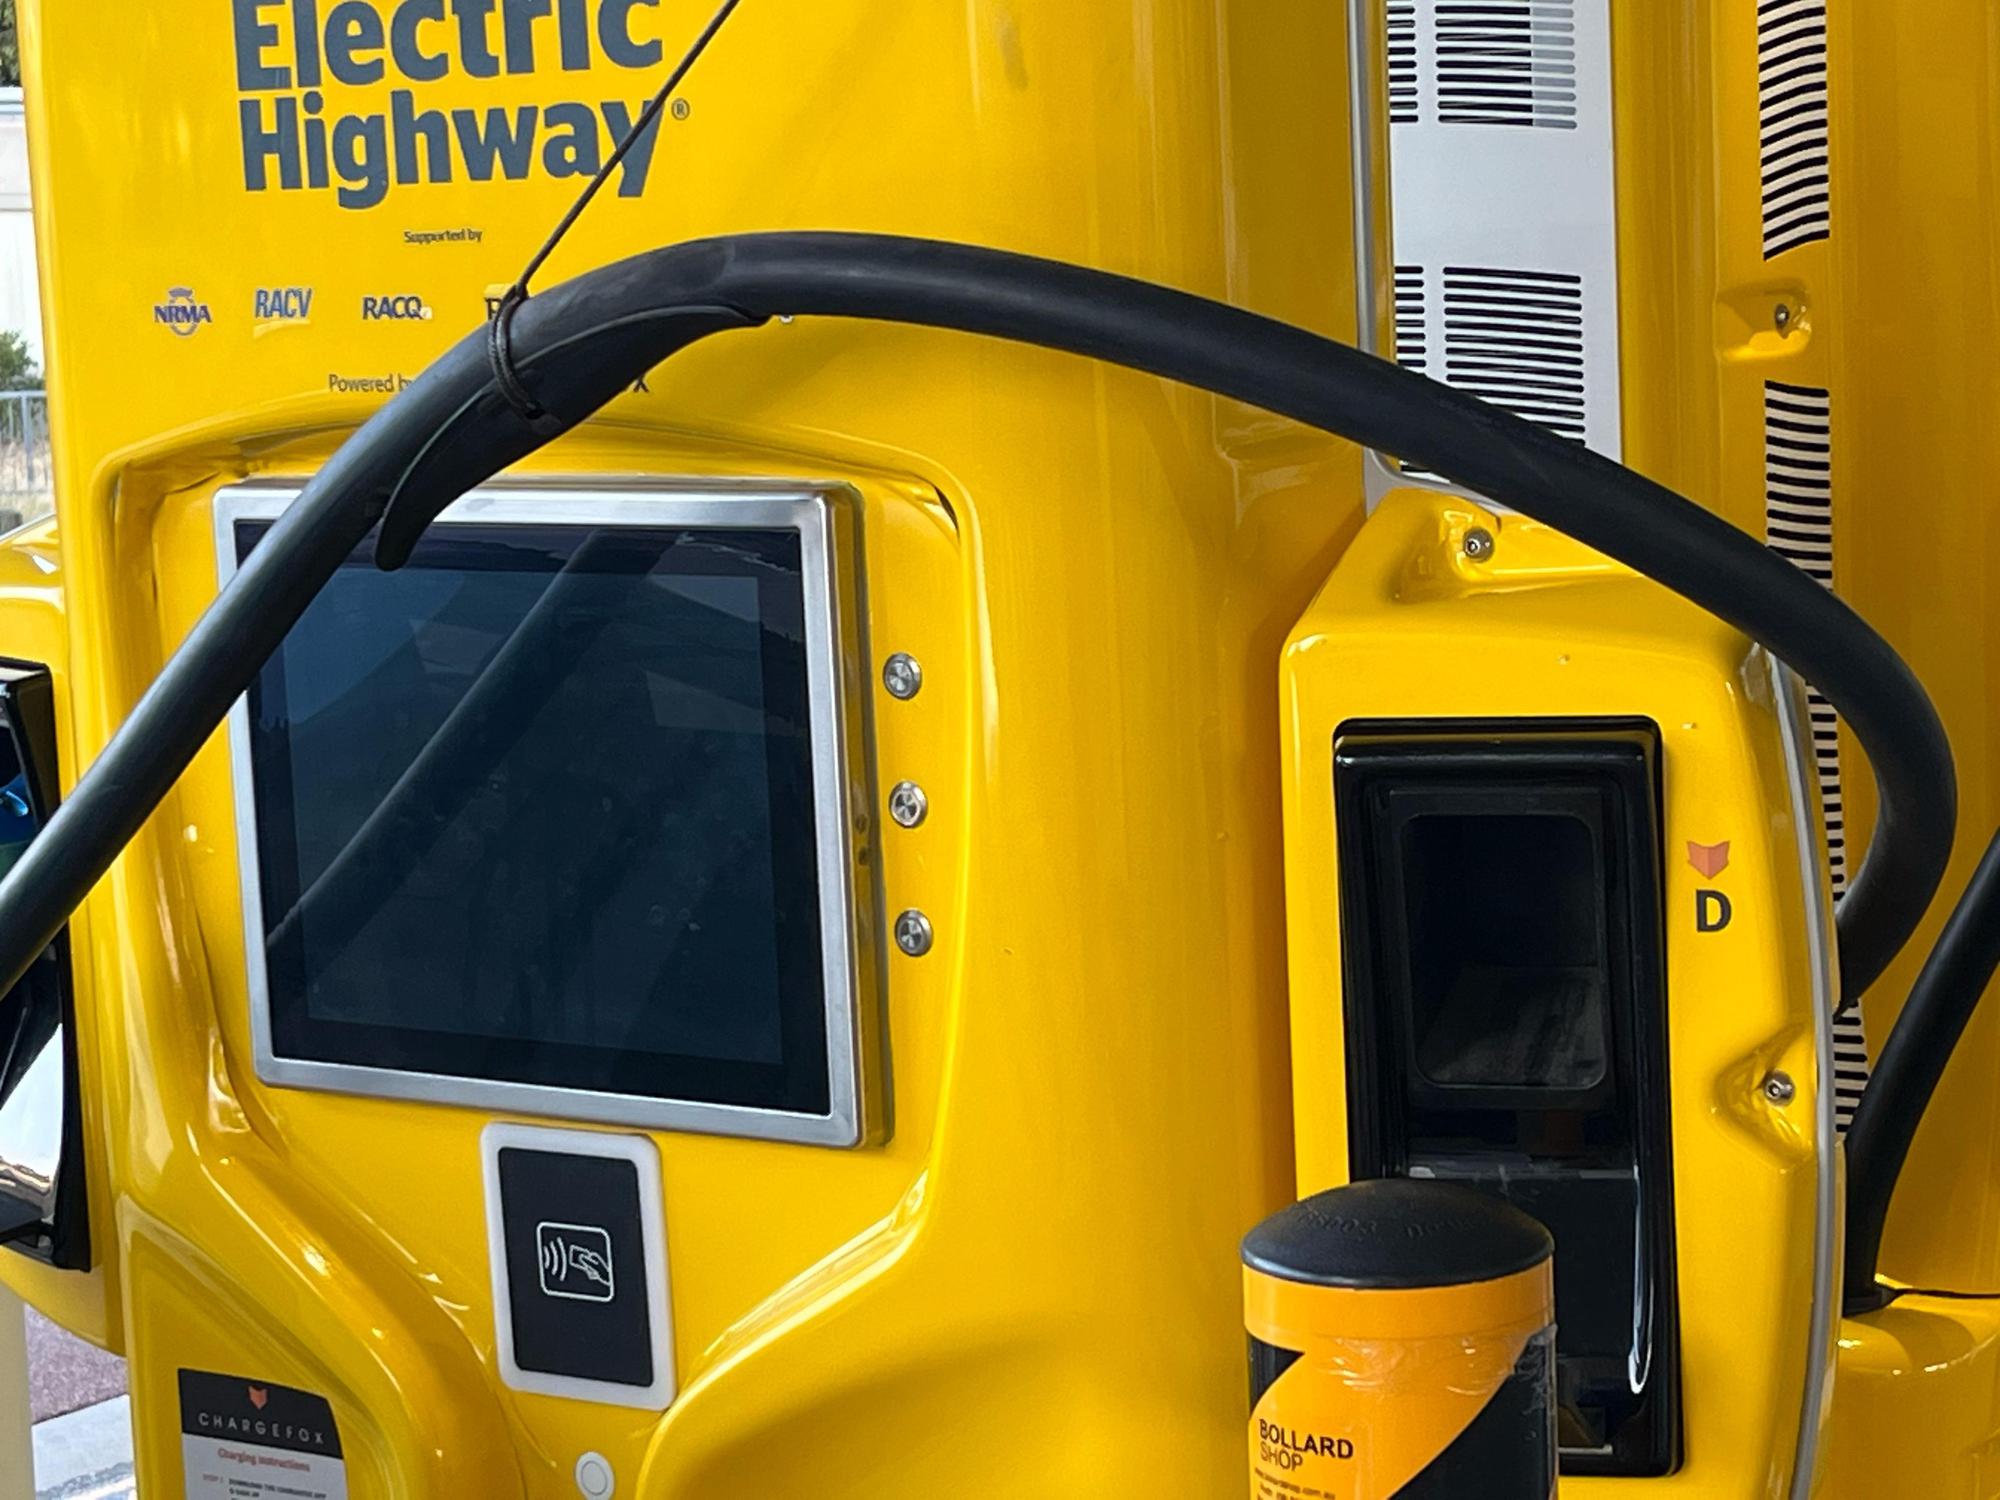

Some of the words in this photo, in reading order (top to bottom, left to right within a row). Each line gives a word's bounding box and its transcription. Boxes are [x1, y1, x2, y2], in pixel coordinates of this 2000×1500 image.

[232, 0, 663, 91] Electric
[467, 228, 483, 243] by
[154, 304, 212, 324] NRMA
[254, 287, 312, 318] RACV
[362, 296, 423, 320] RACQ
[329, 373, 394, 393] Powered
[1696, 889, 1732, 933] D
[198, 1413, 323, 1444] CHARGEFOX
[1259, 1418, 1354, 1459] BOLLARD
[1260, 1442, 1303, 1471] SHOP
